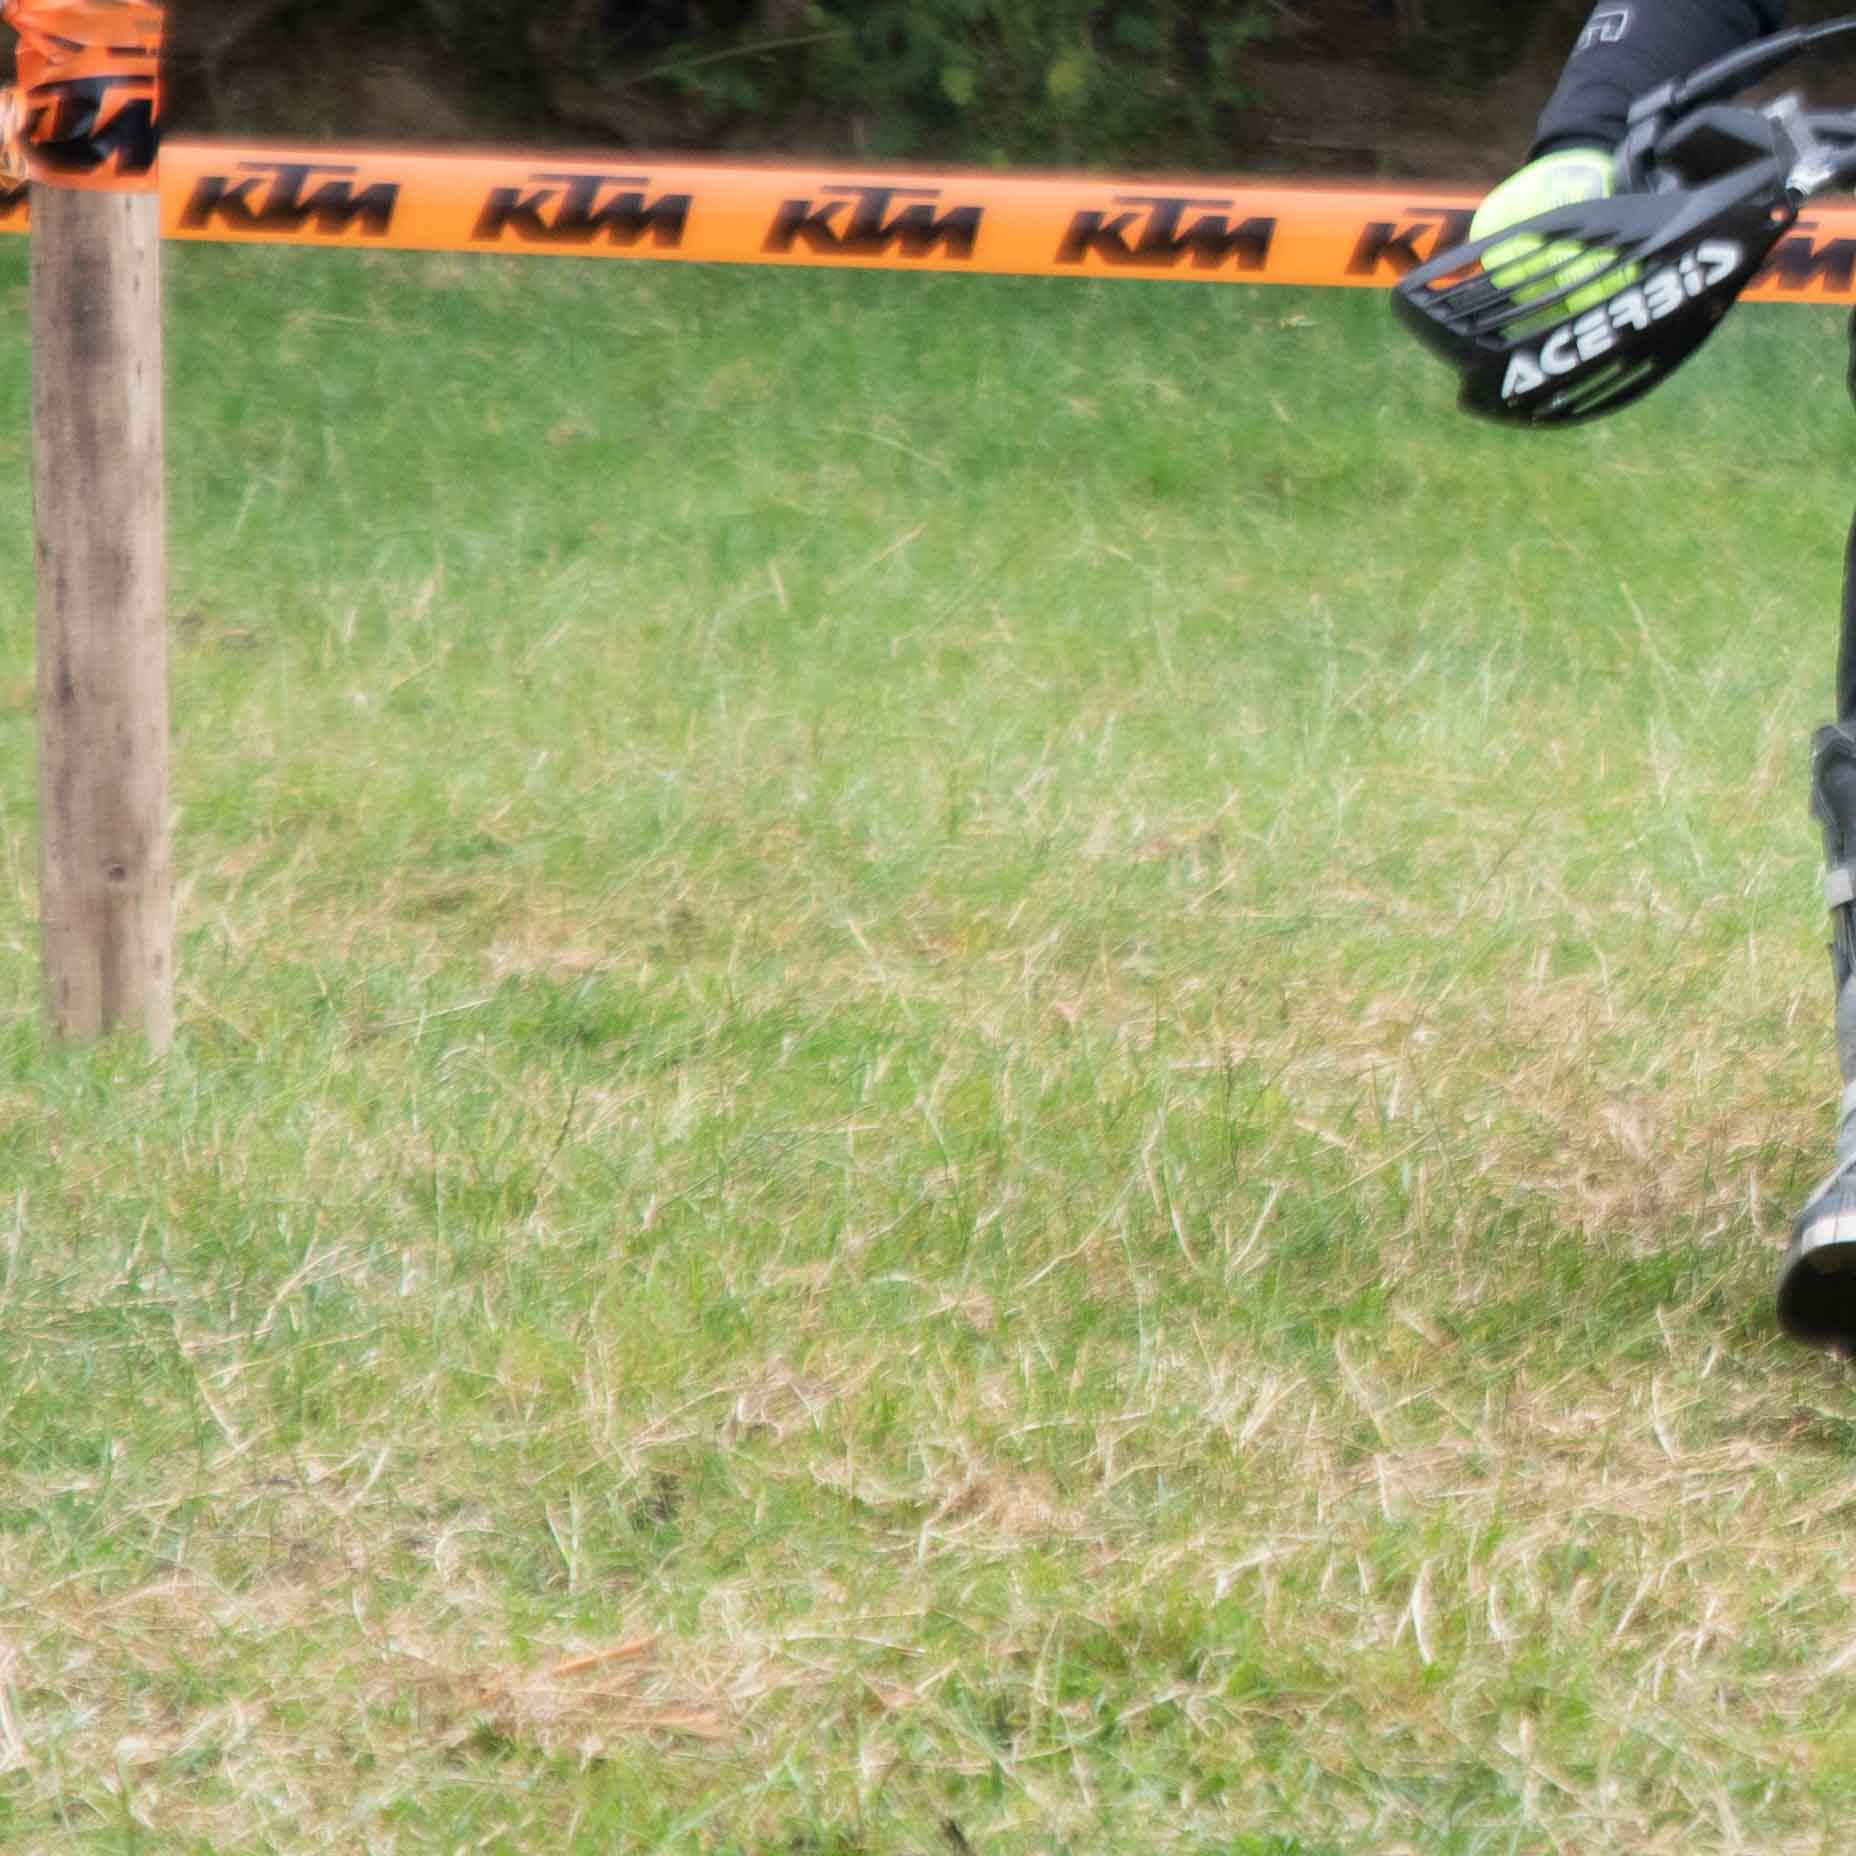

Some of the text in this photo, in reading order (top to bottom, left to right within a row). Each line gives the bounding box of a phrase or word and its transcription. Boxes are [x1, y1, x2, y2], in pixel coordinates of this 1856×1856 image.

[179, 161, 401, 237] KTM
[470, 173, 693, 249] KTM
[761, 185, 985, 260] KTM
[1054, 195, 1278, 271] KTM
[1344, 208, 1478, 276] KT
